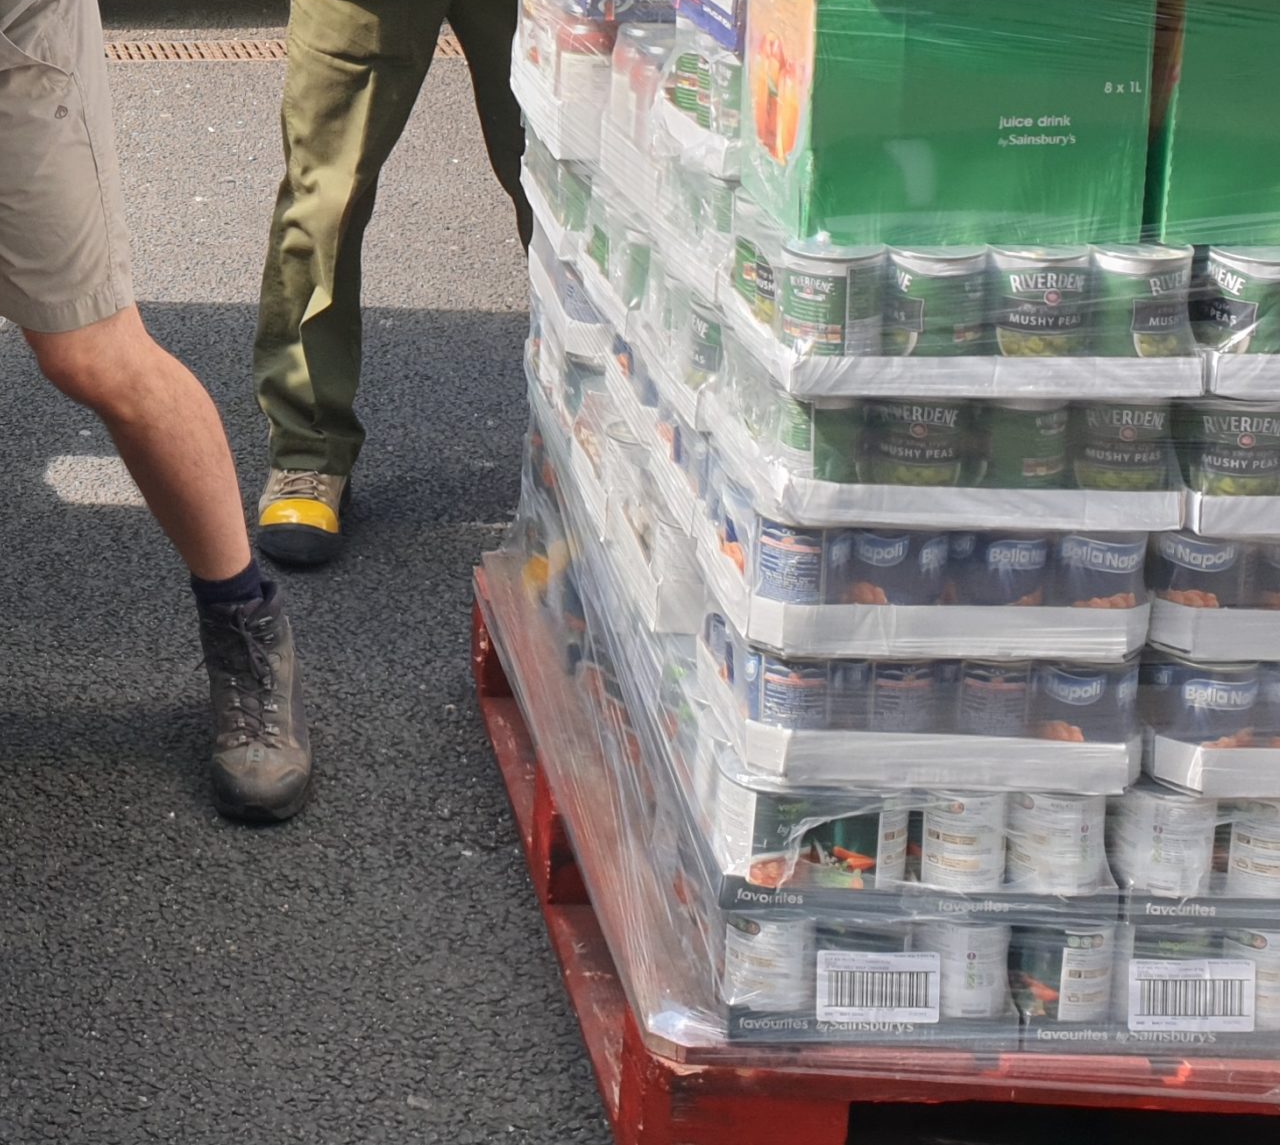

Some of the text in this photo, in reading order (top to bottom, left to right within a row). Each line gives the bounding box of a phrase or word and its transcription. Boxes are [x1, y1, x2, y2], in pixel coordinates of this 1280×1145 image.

[1103, 81, 1142, 93] 8 x 1L
[998, 115, 1070, 130] juice drink
[1008, 134, 1076, 146] Sainsbury's
[1009, 312, 1055, 326] MUSHY
[925, 447, 954, 459] PEAS
[1086, 447, 1130, 462] MUSHY
[1202, 453, 1249, 469] MUSHY
[1177, 544, 1235, 566] Napoli
[1185, 685, 1228, 703] Bella
[938, 899, 1008, 913] favourites
[1145, 903, 1216, 917] favourites
[739, 1016, 809, 1030] favourites
[1037, 1028, 1108, 1041] favourites
